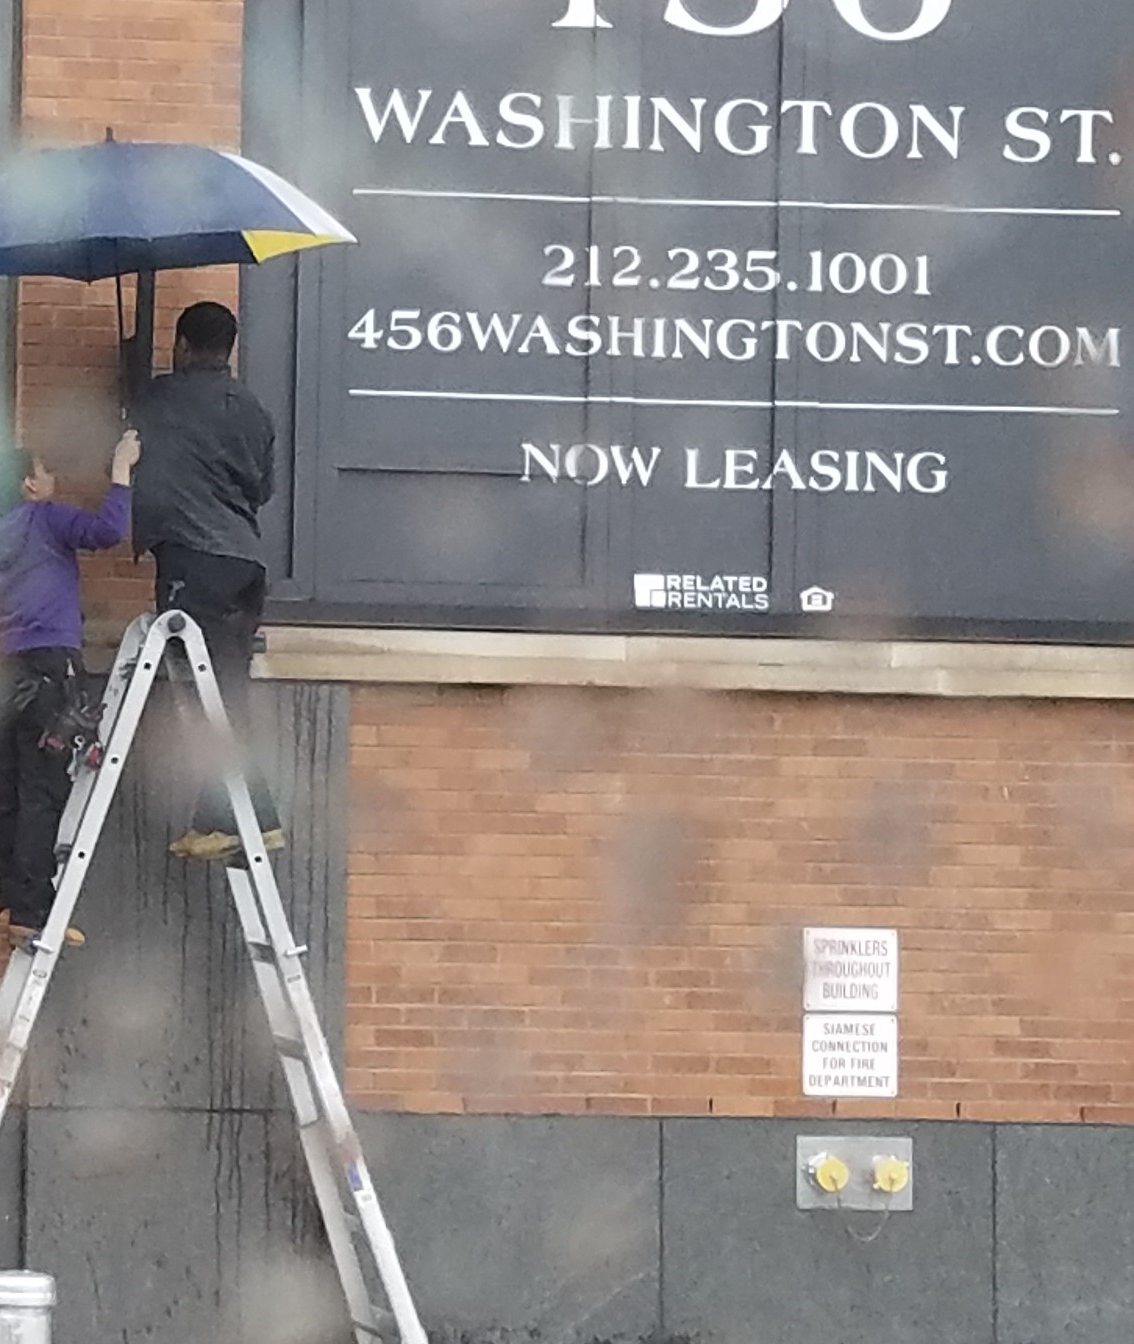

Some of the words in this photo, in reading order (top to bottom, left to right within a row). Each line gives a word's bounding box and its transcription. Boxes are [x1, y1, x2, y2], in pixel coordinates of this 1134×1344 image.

[355, 87, 966, 160] WASHINGTON
[1003, 107, 1122, 166] ST.
[541, 245, 931, 296] 212.235.1001
[347, 309, 1121, 368] 456WASHINGTONST.COM
[519, 443, 661, 486] NOW
[684, 447, 949, 493] LEASING
[666, 575, 768, 592] RELATED
[667, 591, 770, 609] RENTALS
[813, 938, 888, 957] SPRINKLERS
[812, 961, 891, 979] THROUGHOUT
[822, 982, 879, 1000] BUILDING
[823, 1022, 876, 1036] SIAMESE
[812, 1040, 888, 1053] CONNECTION
[822, 1057, 846, 1070] FOR
[851, 1058, 876, 1070] FIRE
[809, 1074, 890, 1088] DEPARTMENT
